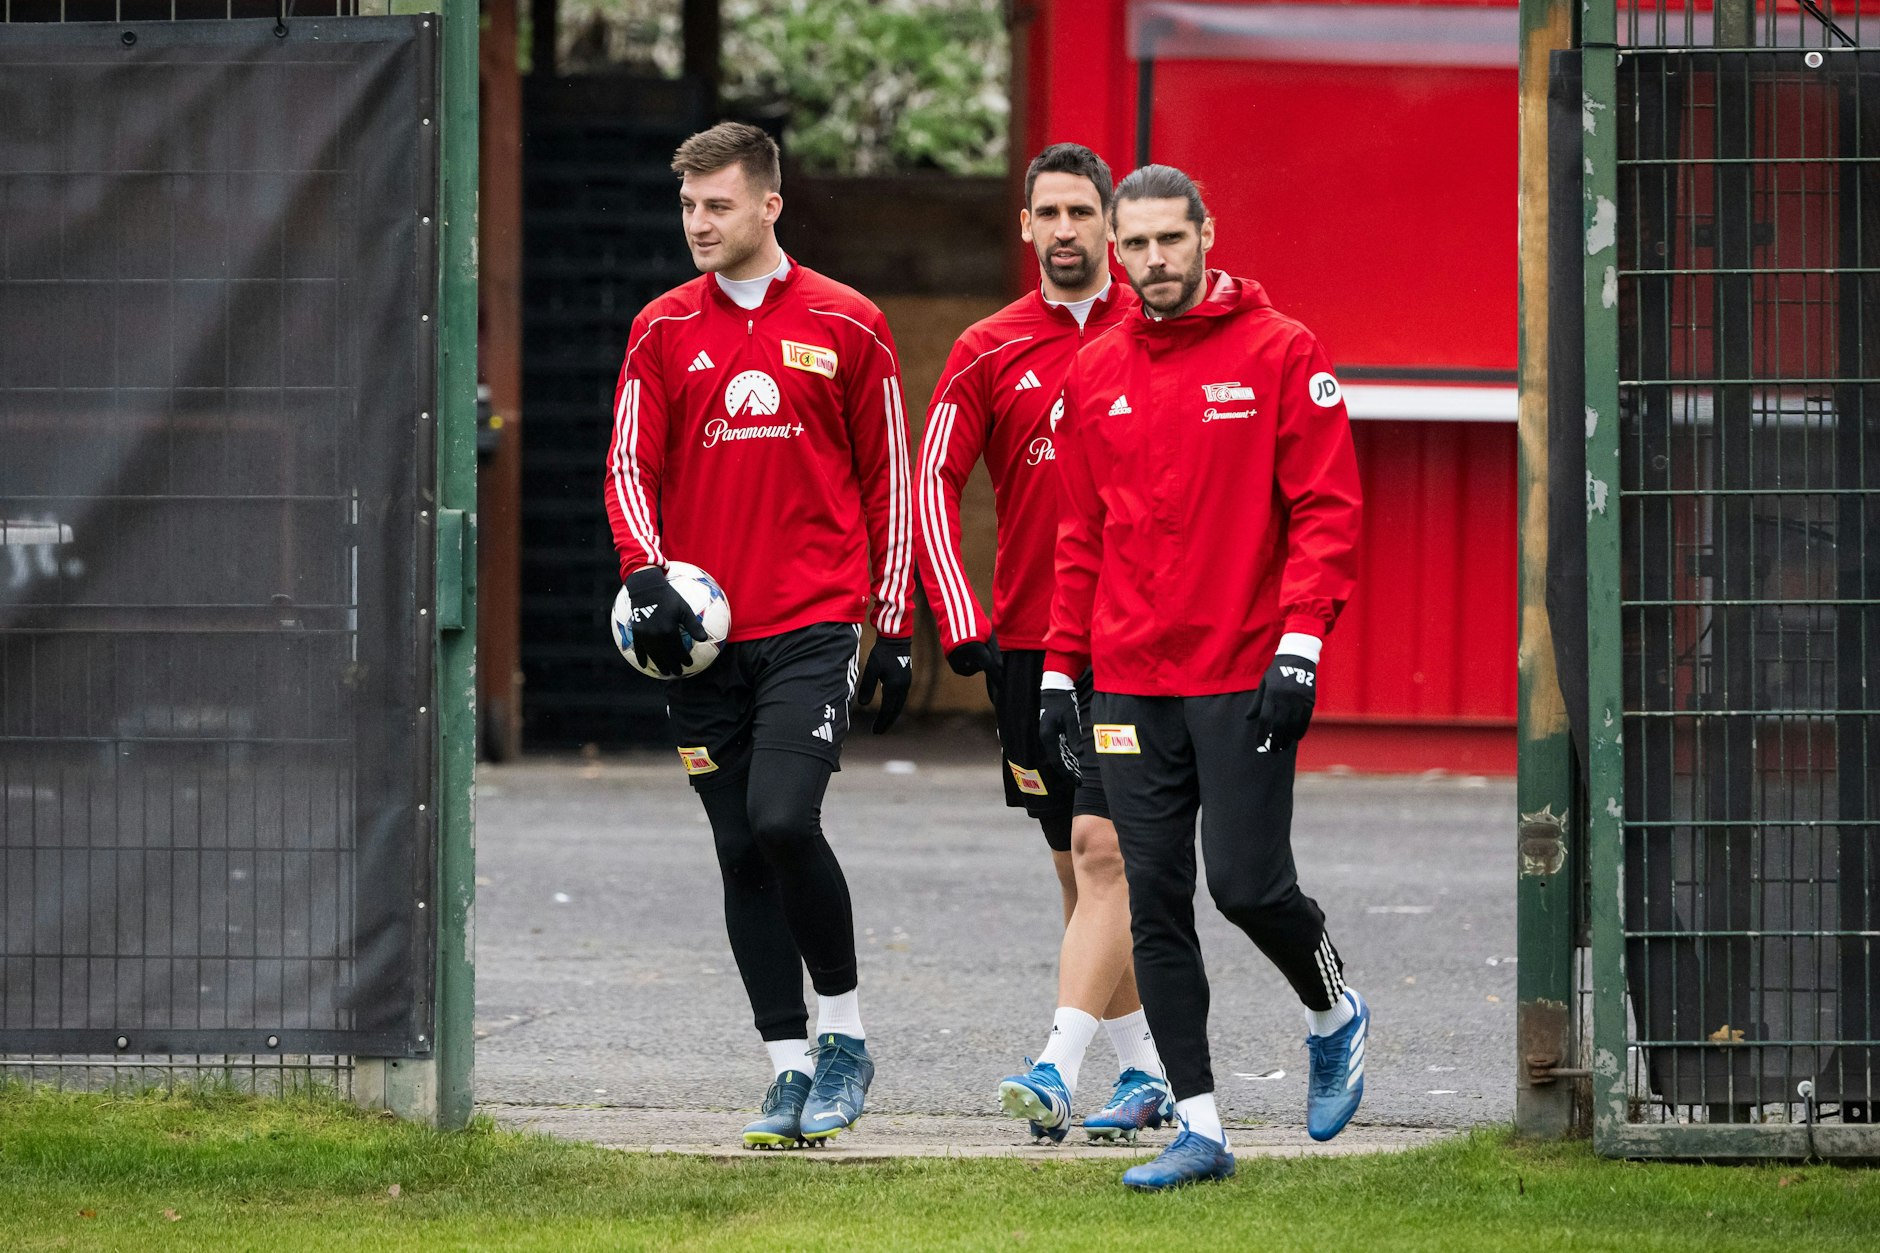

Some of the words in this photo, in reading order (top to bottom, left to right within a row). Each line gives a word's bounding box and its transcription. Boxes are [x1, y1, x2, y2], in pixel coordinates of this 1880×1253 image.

[816, 356, 835, 373] UNION
[1316, 379, 1336, 401] JD
[703, 418, 805, 448] Paramount+
[1295, 668, 1315, 687] 28
[823, 704, 836, 721] 31
[1111, 736, 1134, 747] UNION
